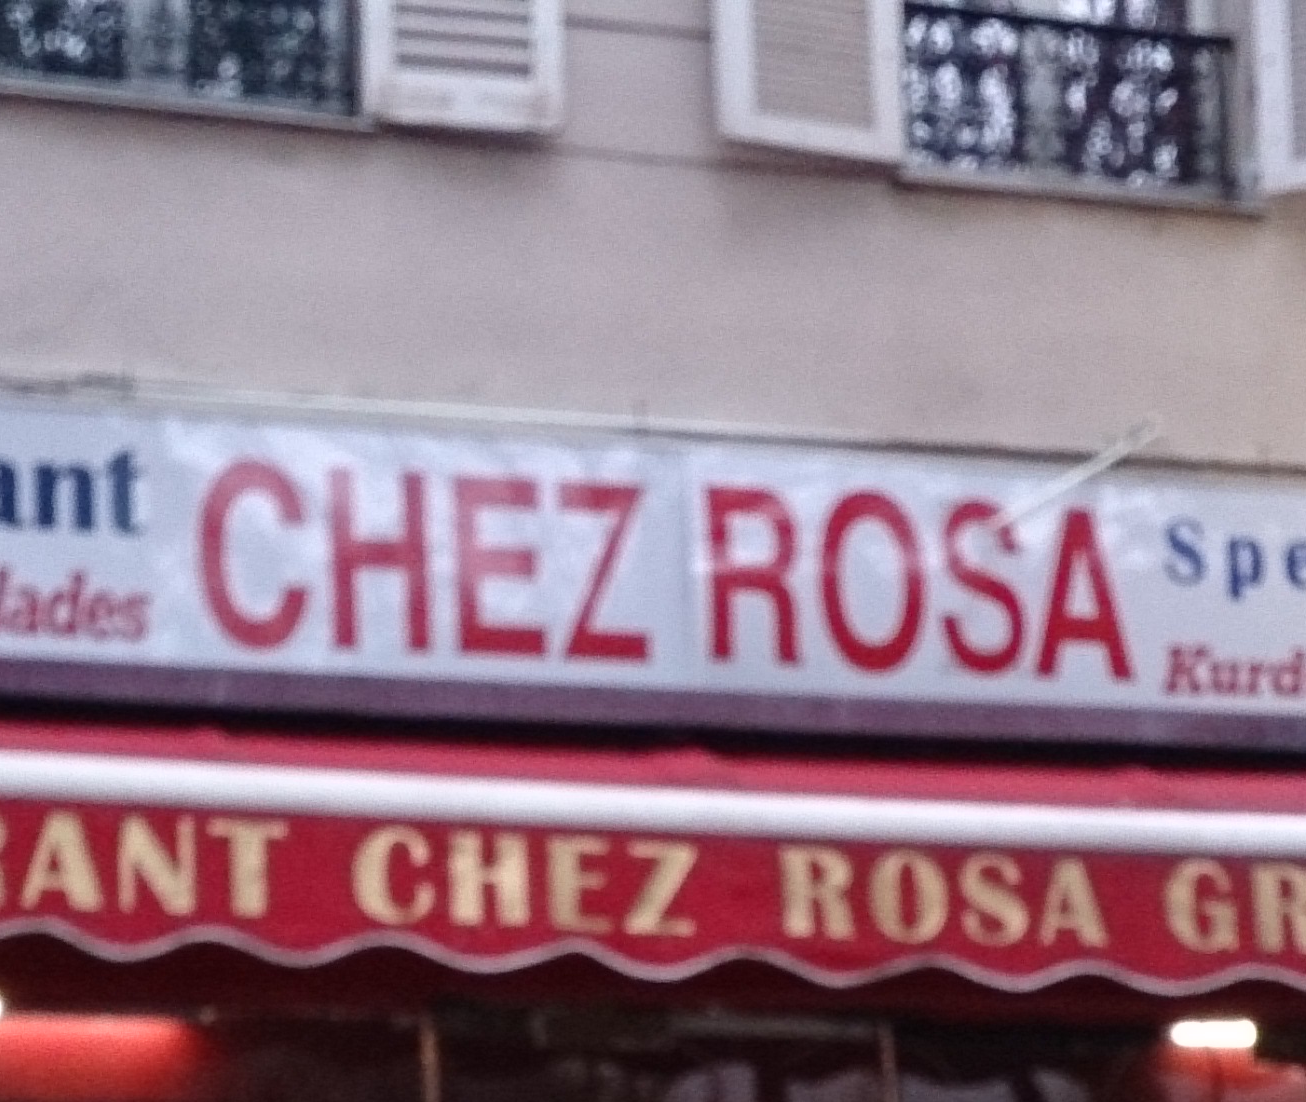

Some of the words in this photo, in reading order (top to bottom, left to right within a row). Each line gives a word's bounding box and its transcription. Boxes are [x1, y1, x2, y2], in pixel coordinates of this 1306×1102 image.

[197, 458, 651, 662] CHEZ
[705, 487, 1134, 682] ROSA
[351, 825, 699, 937] CHEZ
[779, 842, 1109, 948] ROSA
